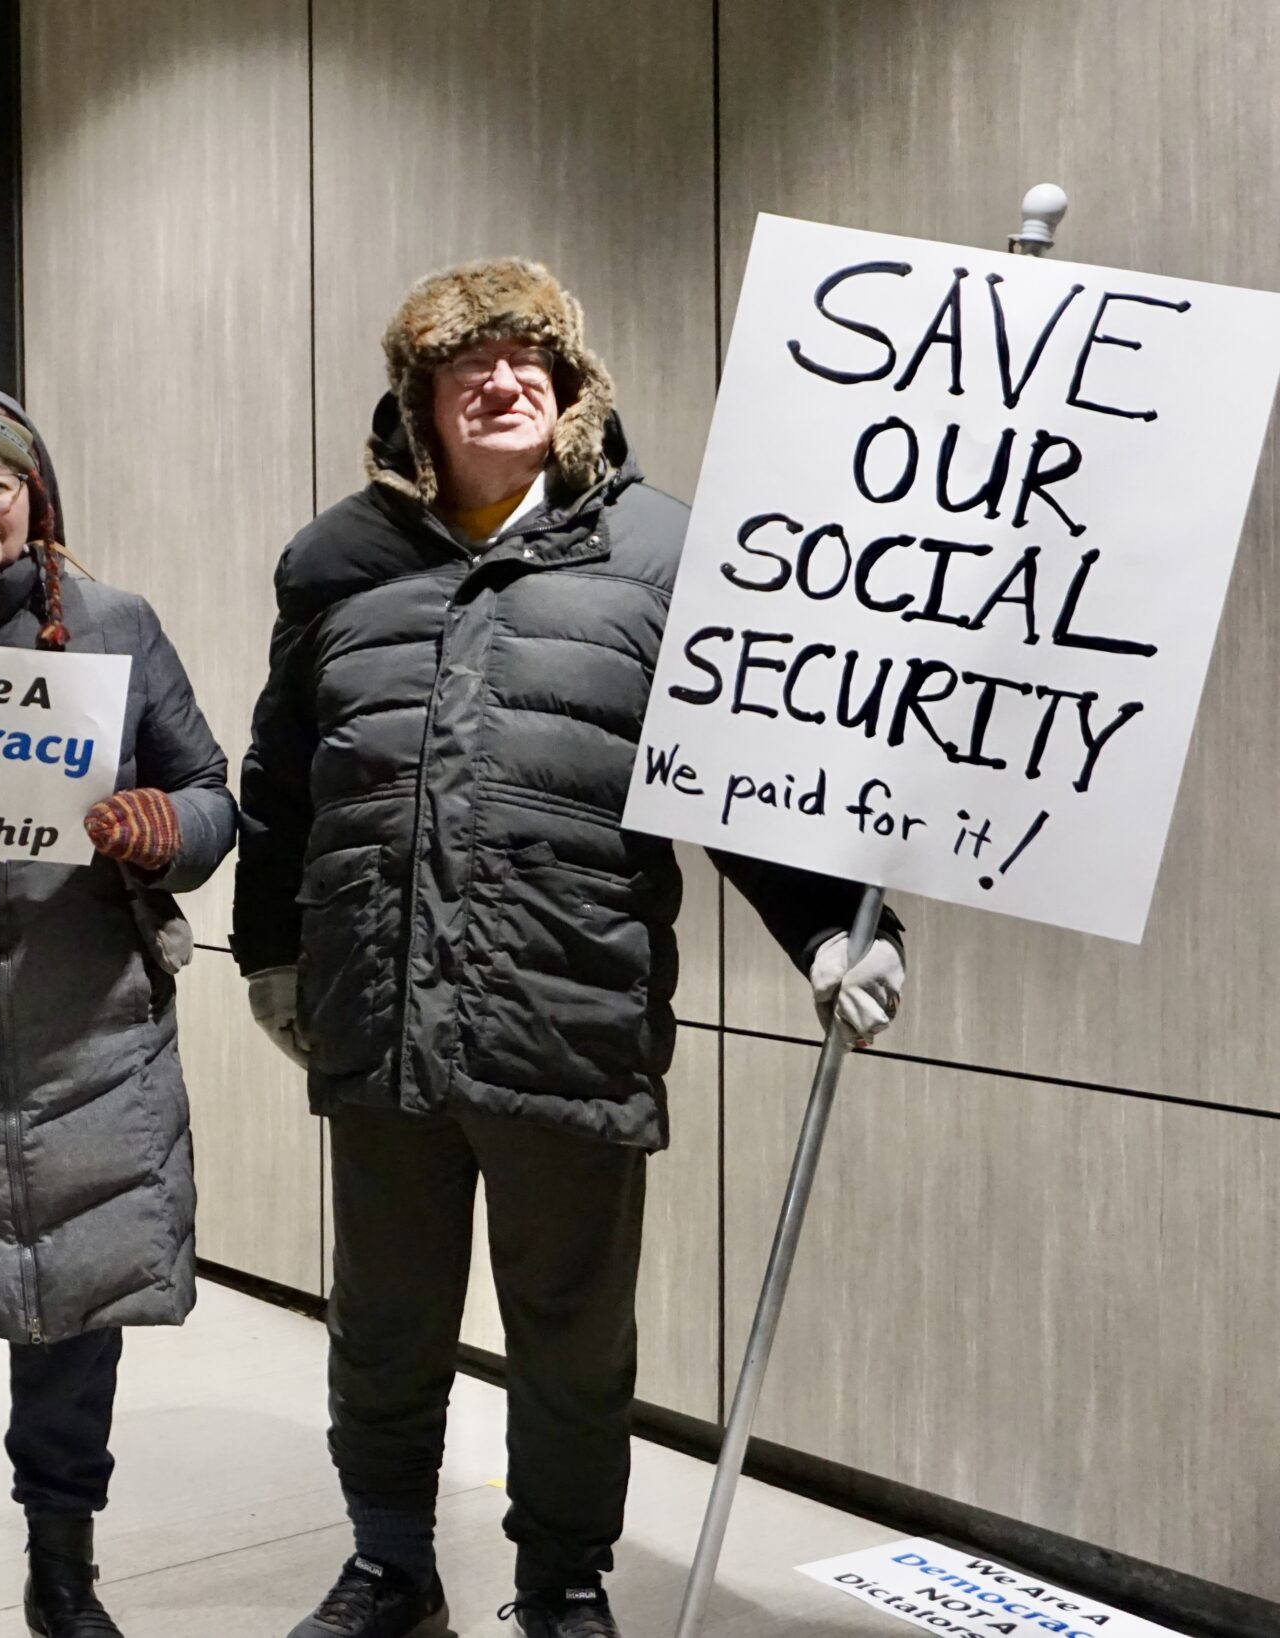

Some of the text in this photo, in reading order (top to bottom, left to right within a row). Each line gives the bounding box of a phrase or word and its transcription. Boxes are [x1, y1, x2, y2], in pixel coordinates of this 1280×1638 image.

[787, 261, 1191, 422] SAVE
[853, 416, 1086, 537] OUR
[720, 512, 1158, 657] SOCIAL
[20, 677, 51, 710] A
[668, 626, 1143, 793] SECURITY
[647, 743, 1050, 891] We paid for it!
[914, 1587, 1018, 1635] NOT A
[965, 1560, 1110, 1626] We Are A
